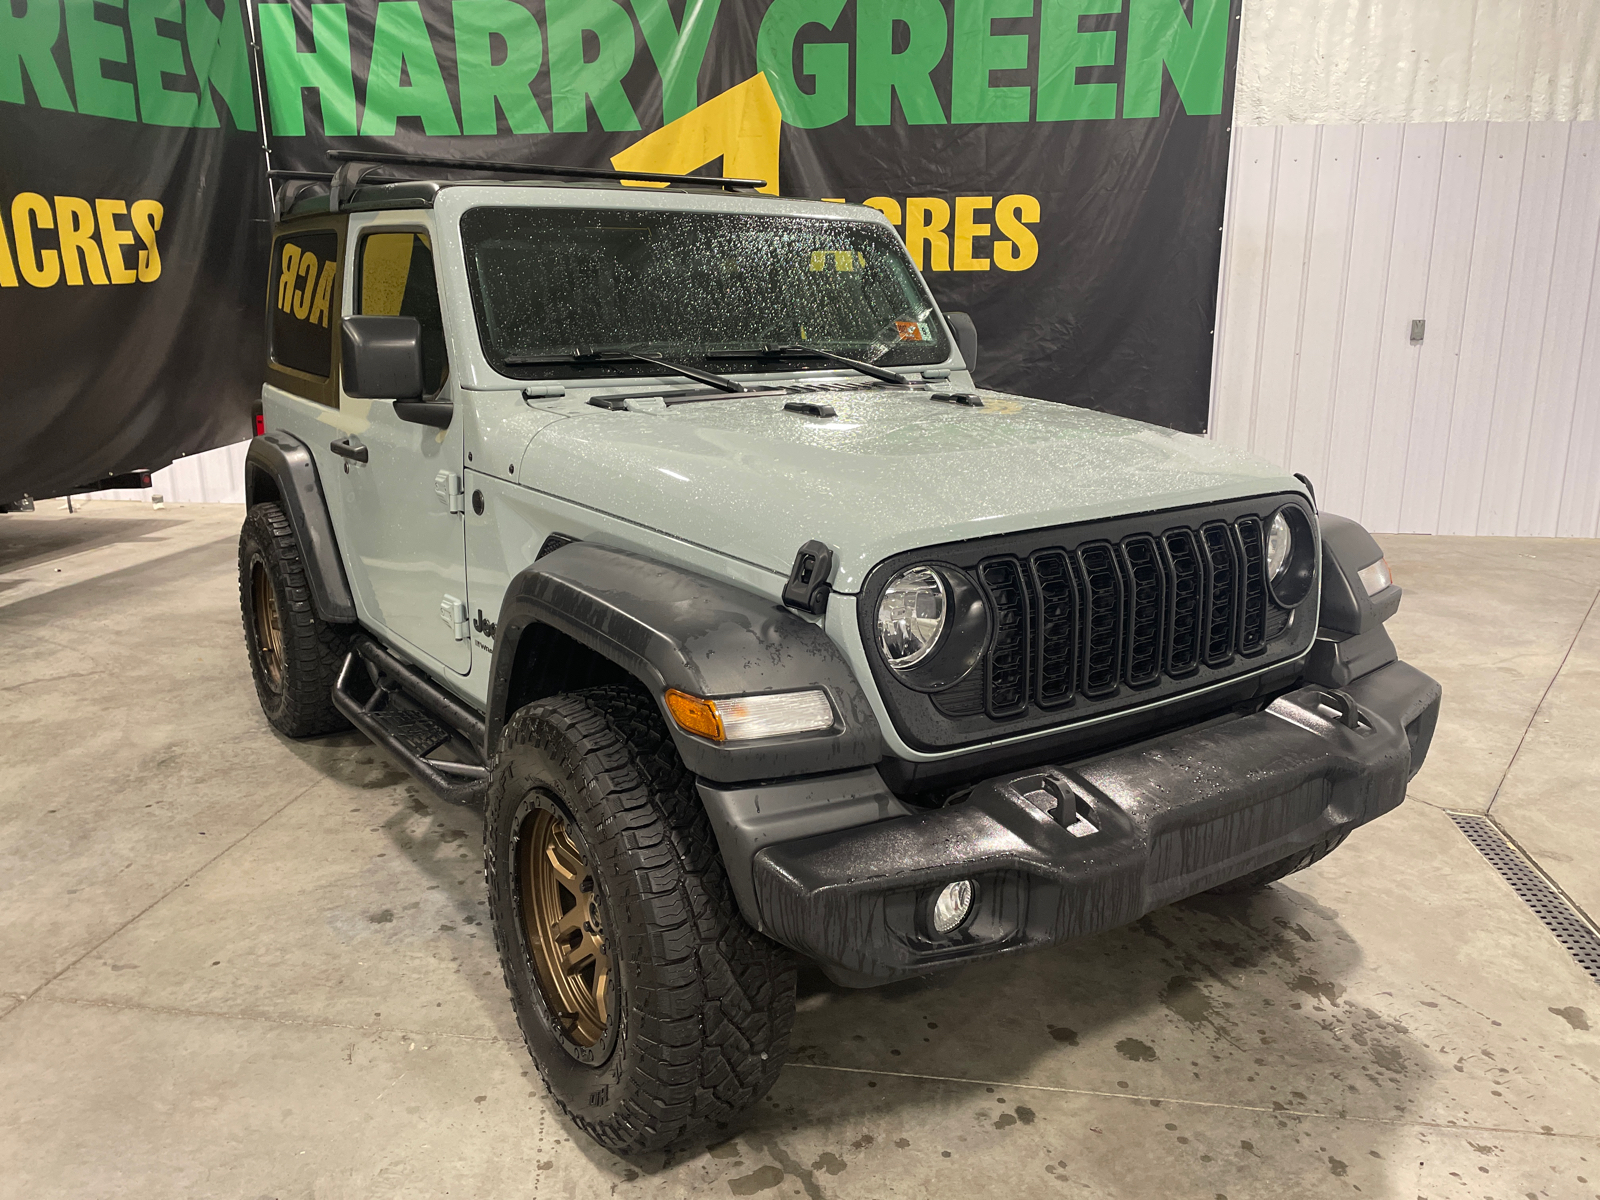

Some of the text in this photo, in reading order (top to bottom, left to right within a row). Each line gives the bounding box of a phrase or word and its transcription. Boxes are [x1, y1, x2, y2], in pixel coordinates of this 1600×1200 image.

[0, 0, 257, 132] REEN
[257, 0, 1227, 137] HARRY GREEN
[820, 195, 1041, 271] RES
[473, 608, 498, 640] Jee
